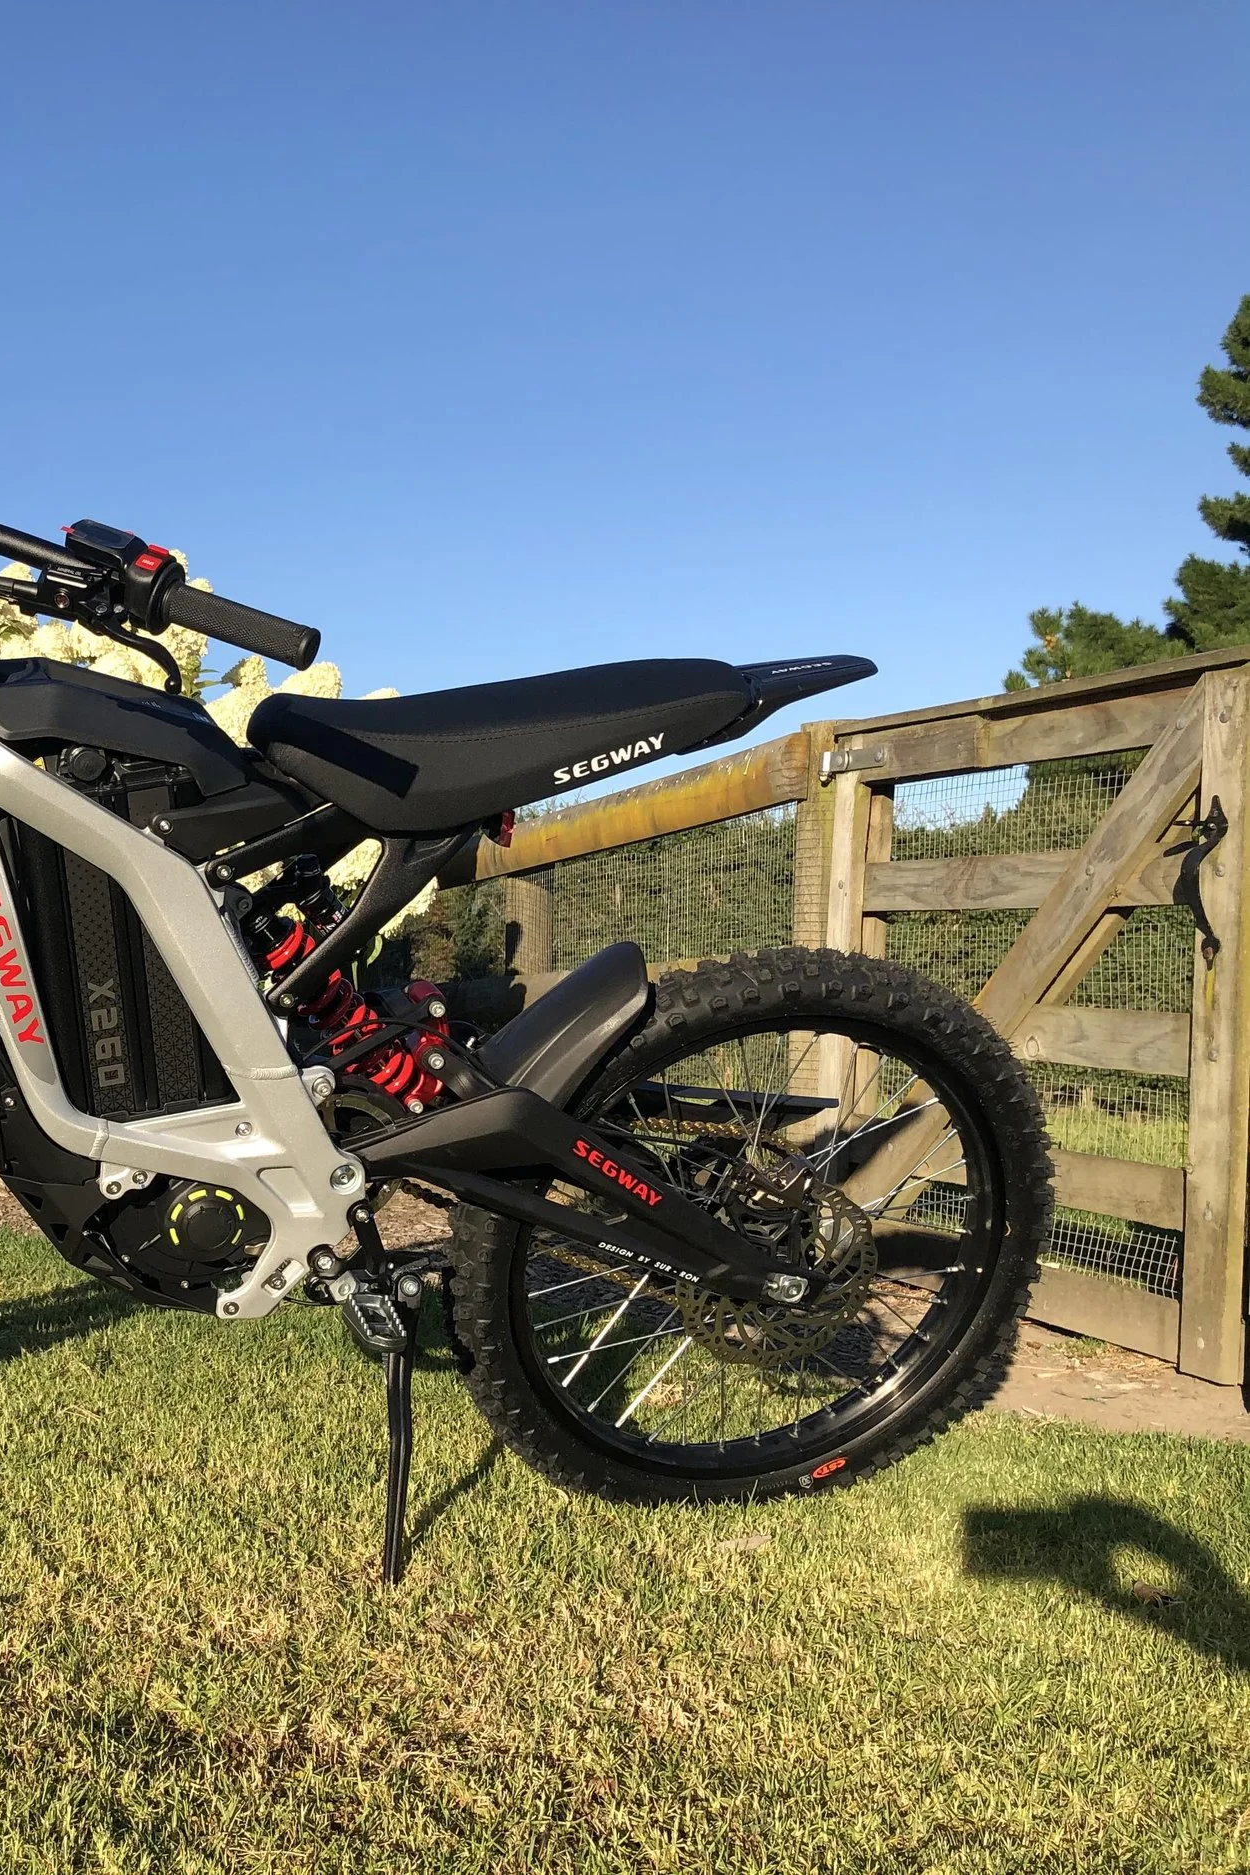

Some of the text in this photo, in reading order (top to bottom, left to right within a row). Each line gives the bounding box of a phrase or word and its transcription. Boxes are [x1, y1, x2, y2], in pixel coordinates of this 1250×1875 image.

[553, 732, 665, 785] SEGWAY
[87, 978, 126, 1088] X260
[572, 1139, 663, 1207] SEGWAY
[598, 1241, 634, 1258] DESIGN
[637, 1255, 651, 1264] BY
